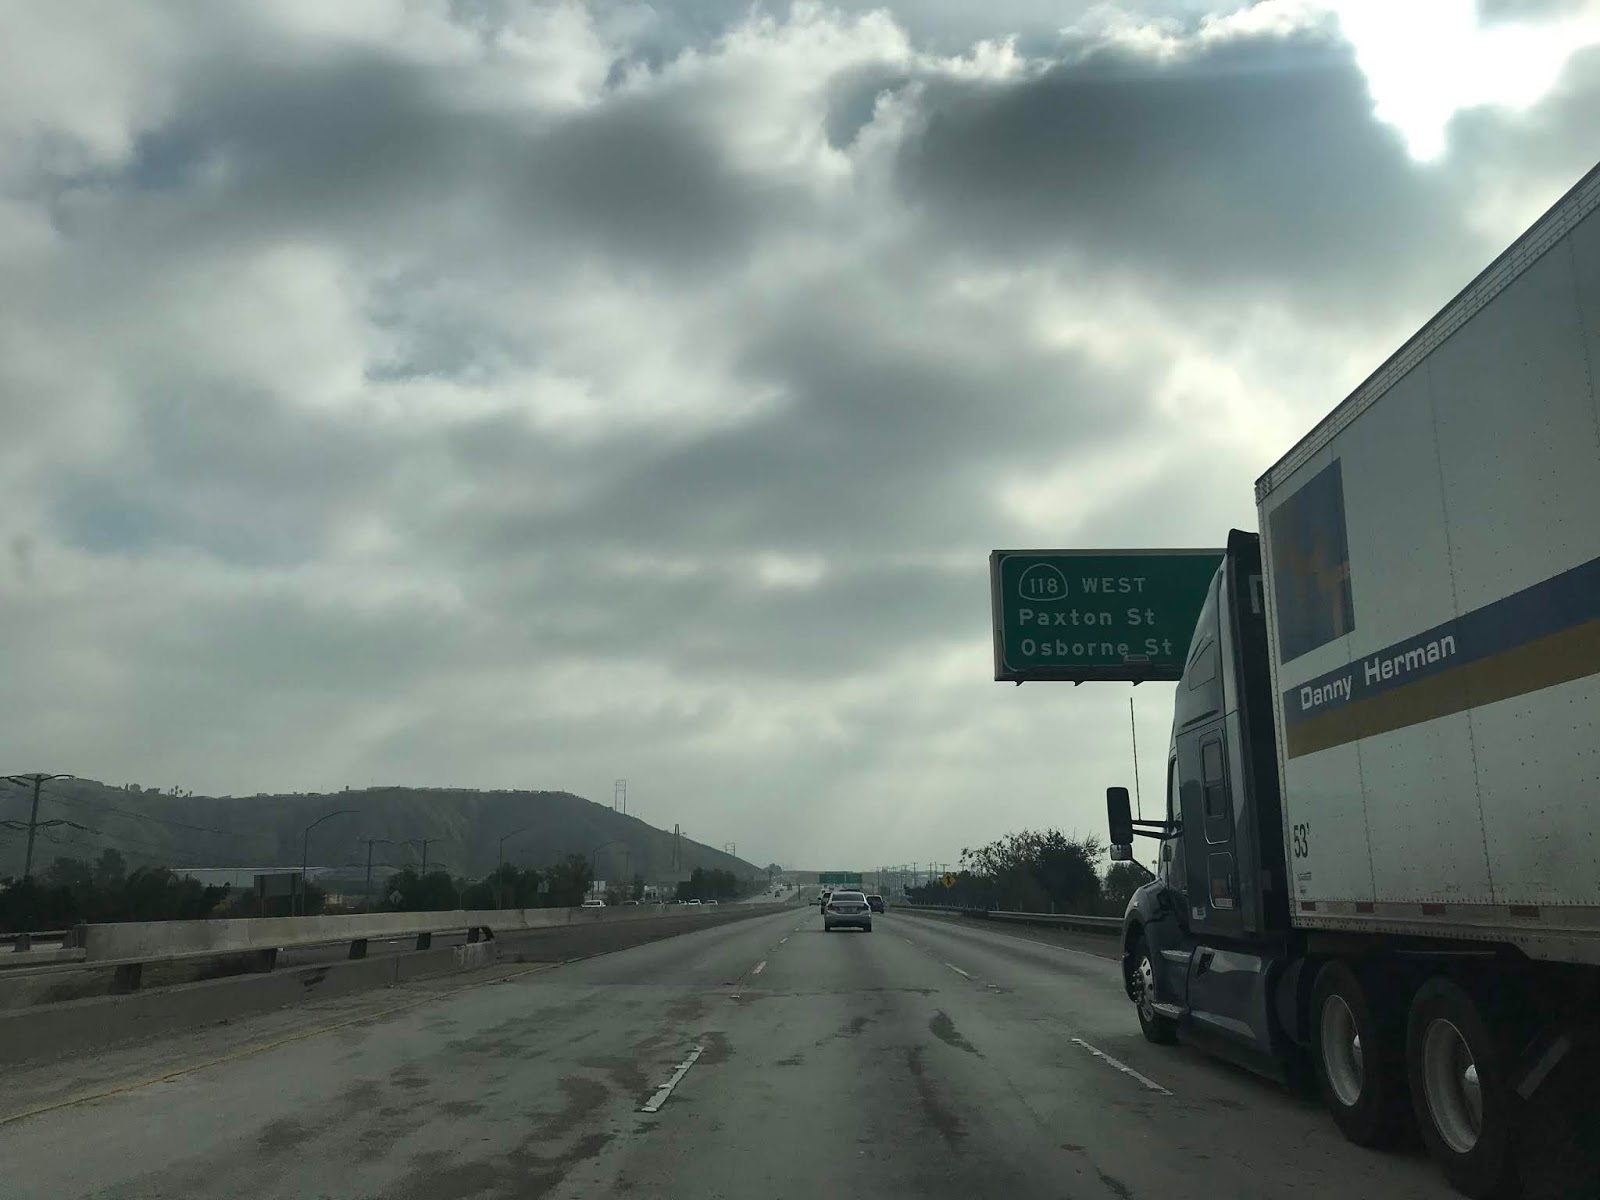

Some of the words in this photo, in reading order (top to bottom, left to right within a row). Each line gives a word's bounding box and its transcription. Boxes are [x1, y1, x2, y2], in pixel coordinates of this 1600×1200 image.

[1029, 577, 1059, 594] 118
[1081, 577, 1147, 594] WEST
[1018, 608, 1113, 626] Paxton
[1126, 607, 1156, 626] St
[1020, 638, 1130, 657] Osborne
[1144, 638, 1174, 656] St
[1300, 674, 1353, 711] Danny
[1364, 634, 1456, 686] Herman
